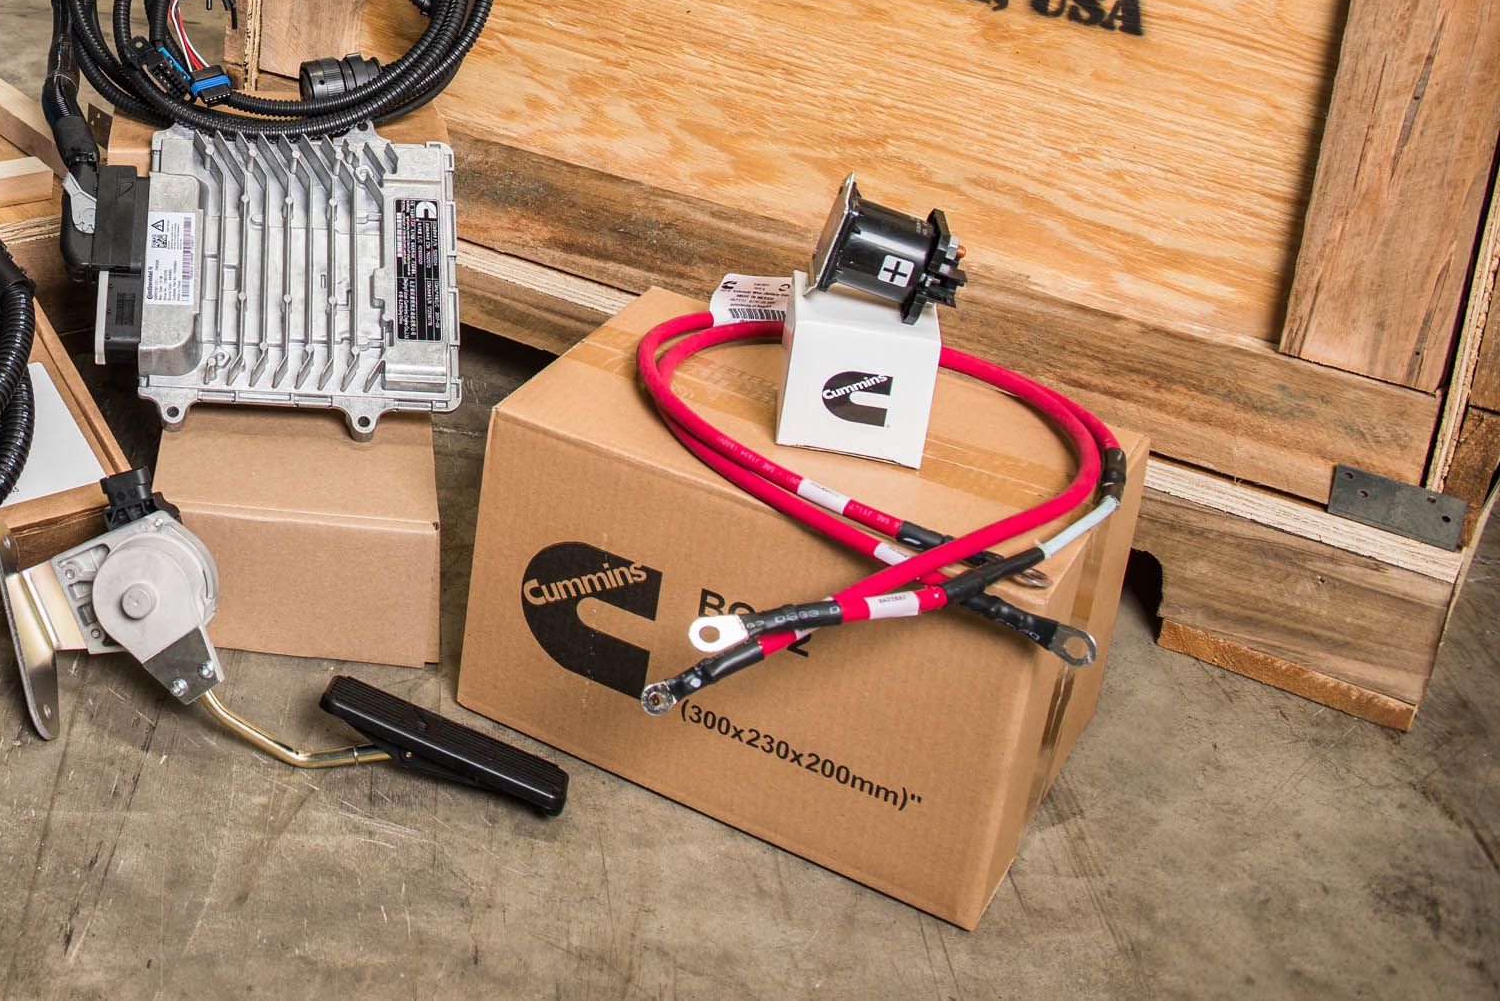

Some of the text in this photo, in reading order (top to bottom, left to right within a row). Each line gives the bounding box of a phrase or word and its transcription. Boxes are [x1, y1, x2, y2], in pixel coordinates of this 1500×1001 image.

[821, 374, 889, 400] Cummins
[762, 461, 776, 473] SAE
[521, 560, 649, 607] Cummins
